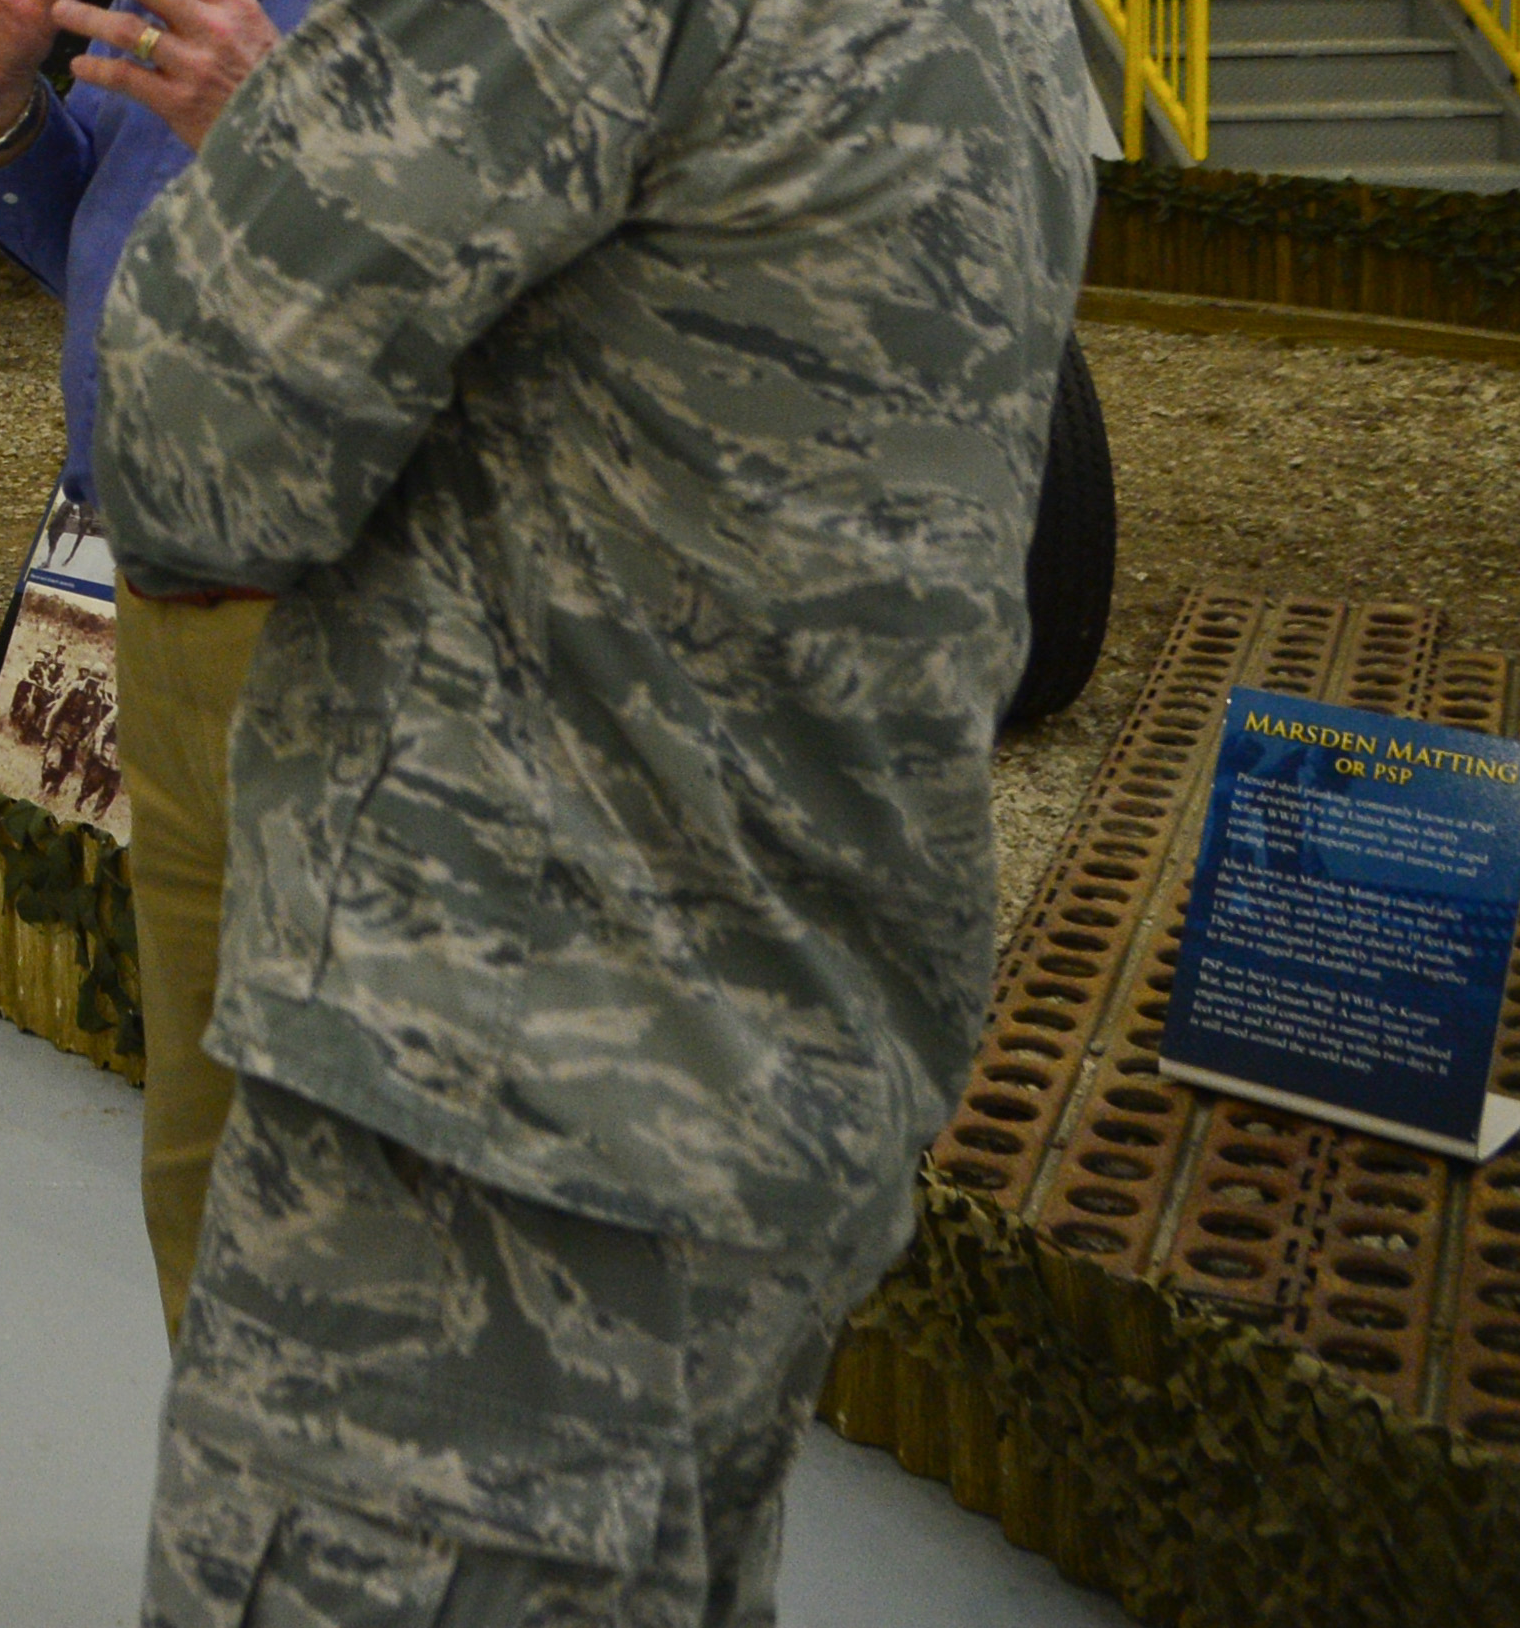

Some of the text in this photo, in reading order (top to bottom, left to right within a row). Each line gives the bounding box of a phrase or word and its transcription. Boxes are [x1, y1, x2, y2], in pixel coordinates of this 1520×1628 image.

[1244, 710, 1519, 785] MARSDEN MATTING
[1335, 757, 1413, 786] OR PSP
